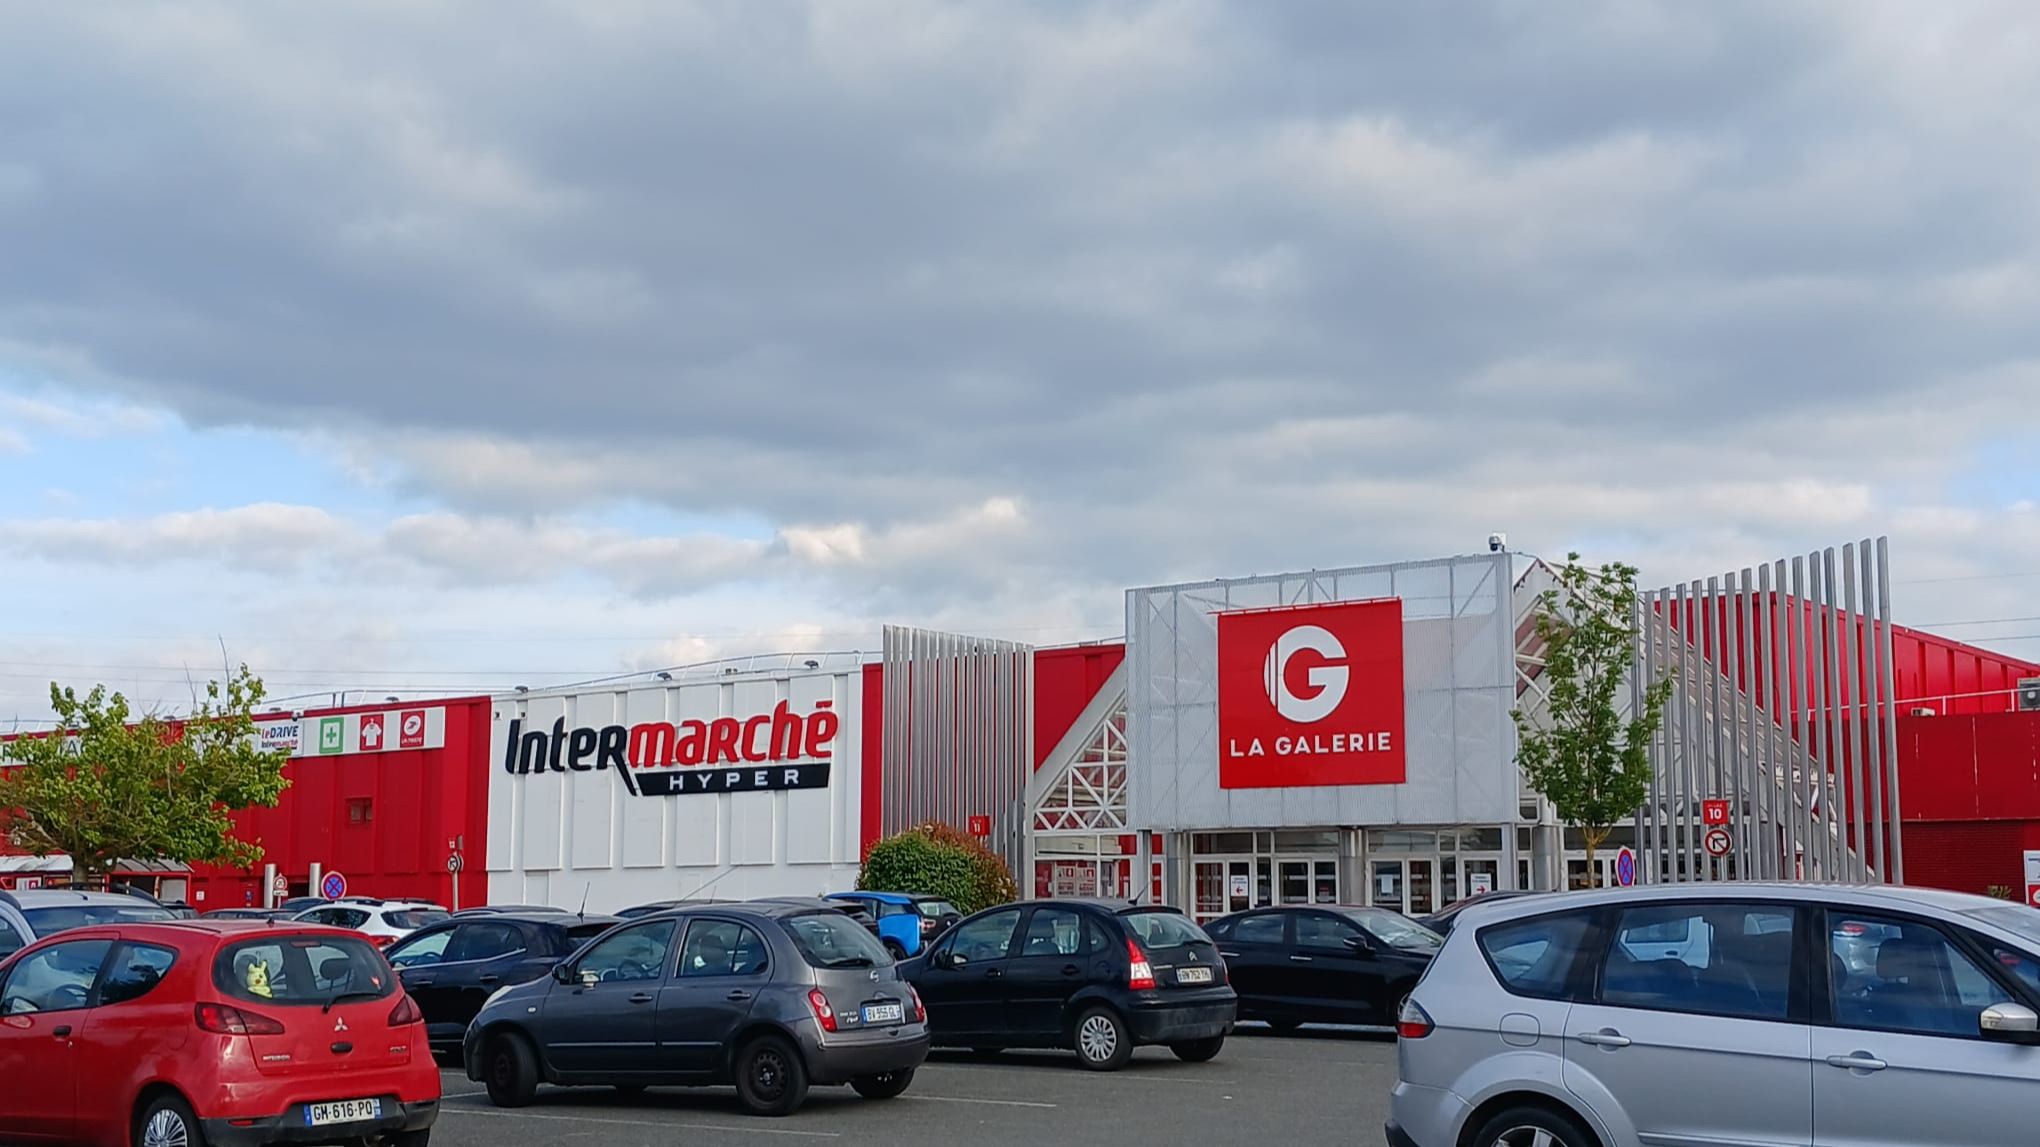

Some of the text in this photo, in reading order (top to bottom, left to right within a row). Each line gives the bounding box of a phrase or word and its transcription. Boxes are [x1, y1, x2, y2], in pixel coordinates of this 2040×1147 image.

[1263, 625, 1350, 723] G
[504, 698, 839, 796] Intermarché
[1230, 732, 1392, 757] LA GALERIE
[669, 769, 799, 791] HYPER
[1709, 808, 1722, 820] 10
